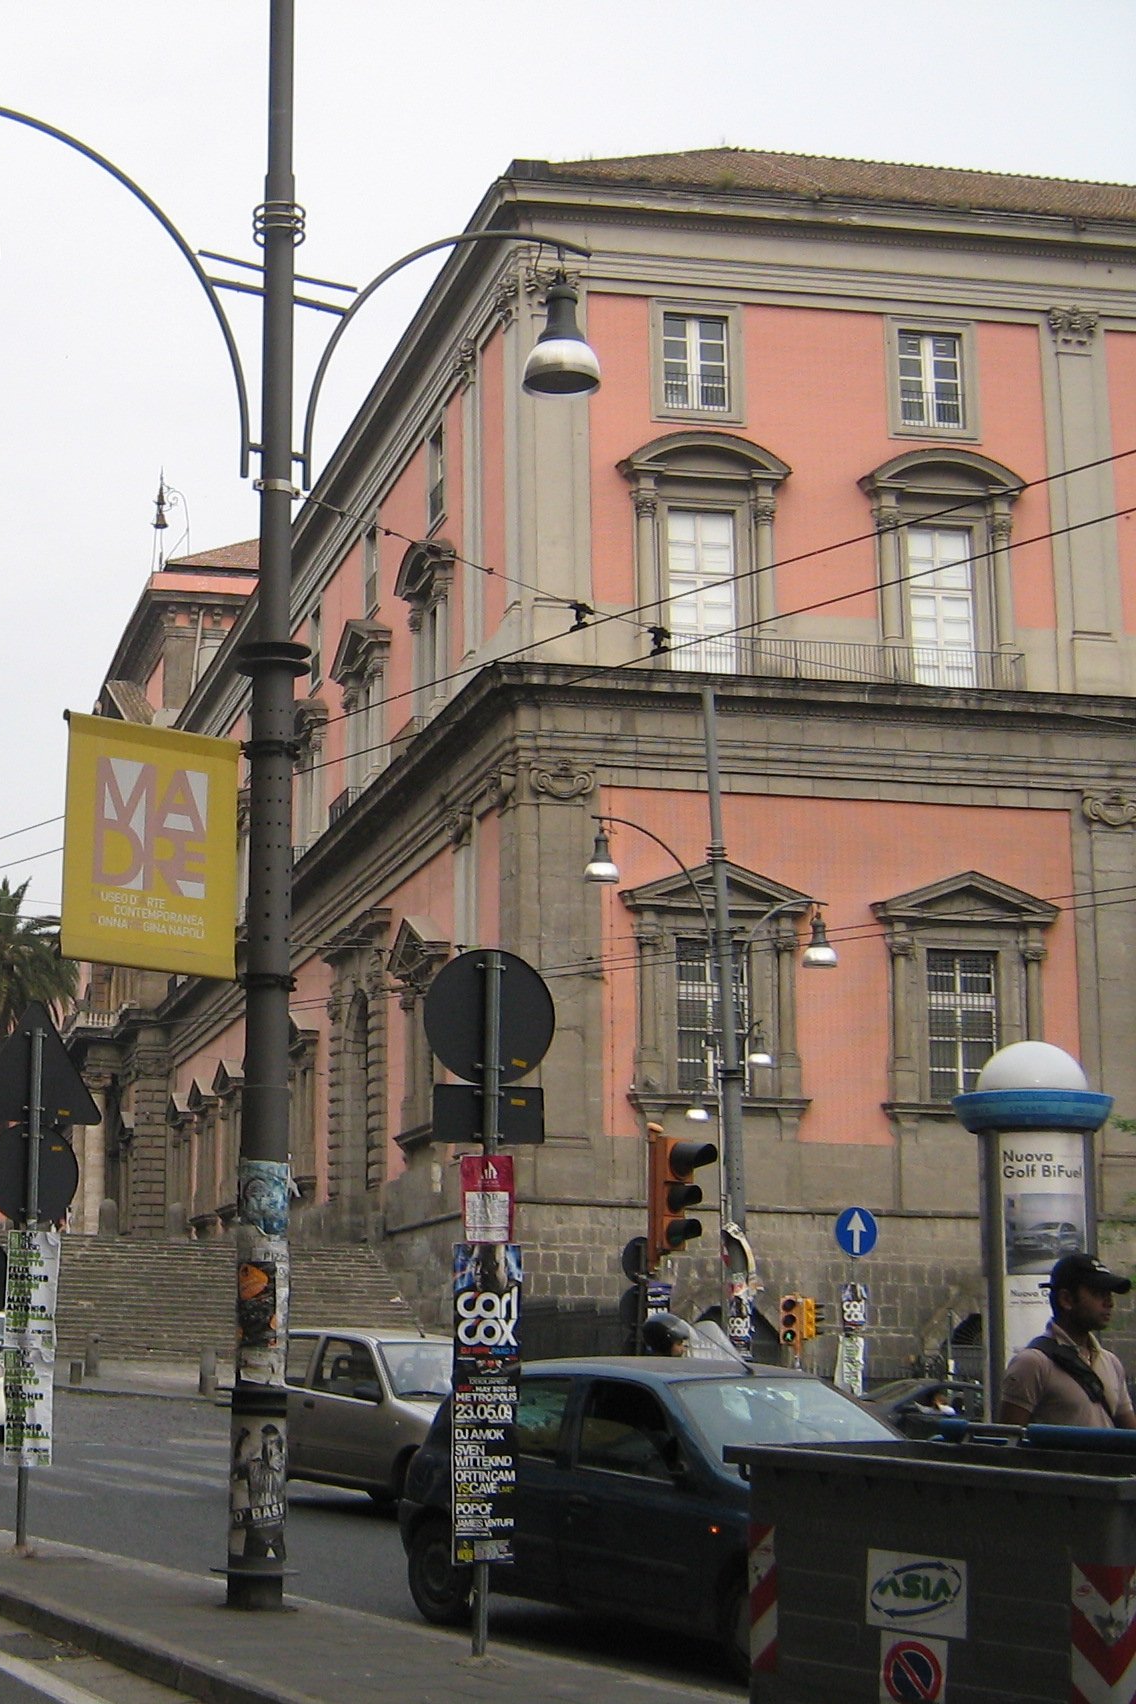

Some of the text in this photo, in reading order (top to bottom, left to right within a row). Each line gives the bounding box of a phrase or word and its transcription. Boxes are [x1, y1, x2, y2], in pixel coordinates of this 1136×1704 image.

[113, 904, 205, 927] CONTEMPORANEA
[168, 925, 206, 940] NAPOLI
[1002, 1150, 1054, 1163] Nuova
[1002, 1164, 1083, 1179] Golf BiFuel
[456, 1285, 519, 1319] carl
[457, 1318, 519, 1347] cox
[455, 1392, 517, 1403] METROPOLIS
[455, 1404, 513, 1420] 23.05.09
[455, 1429, 505, 1441] DJ AMOK
[455, 1445, 485, 1456] SVEN
[454, 1455, 513, 1467] WITTEKIND
[455, 1470, 516, 1482] ORTIN CAM
[455, 1503, 494, 1515] POPOF
[877, 1573, 952, 1602] ASIA
